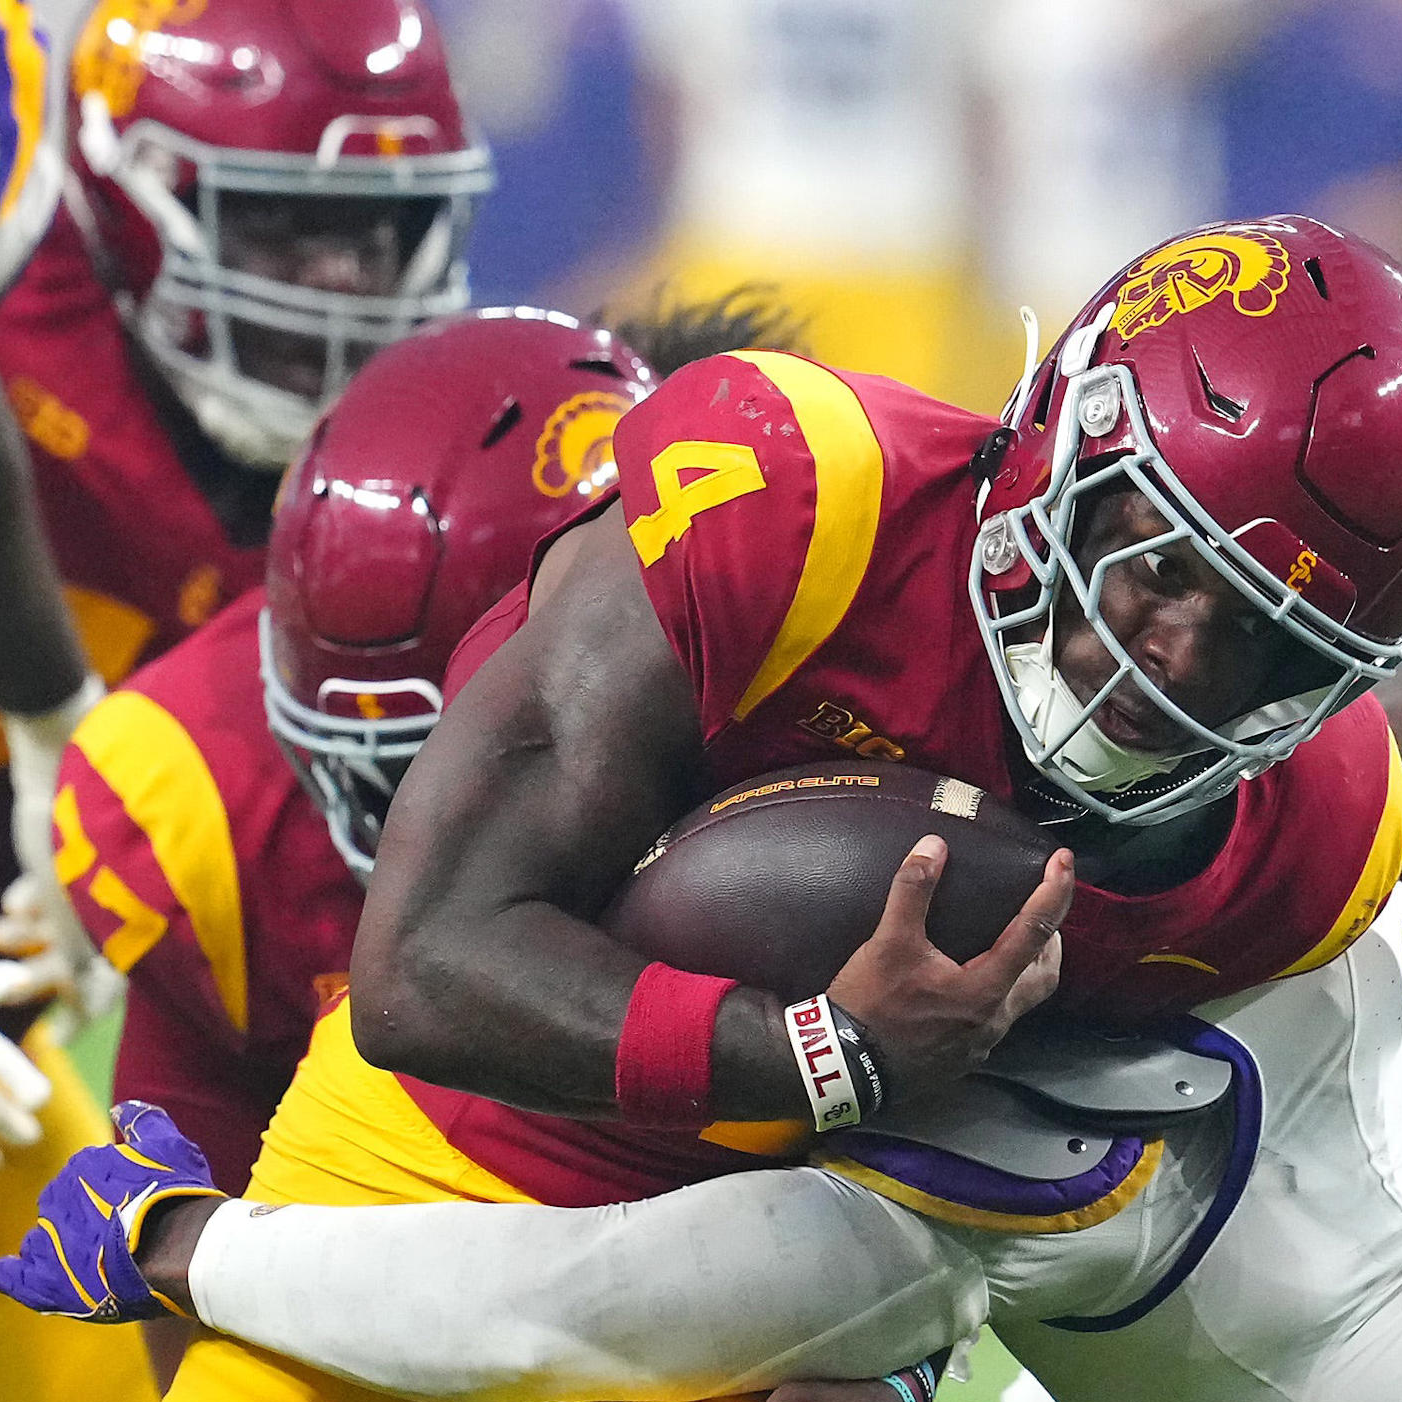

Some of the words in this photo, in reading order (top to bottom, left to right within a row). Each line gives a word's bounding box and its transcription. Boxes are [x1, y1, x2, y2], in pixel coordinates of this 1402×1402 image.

[627, 440, 766, 568] 4
[710, 780, 796, 814] VAPOR
[797, 775, 880, 789] ELITE
[859, 1051, 876, 1075] USC
